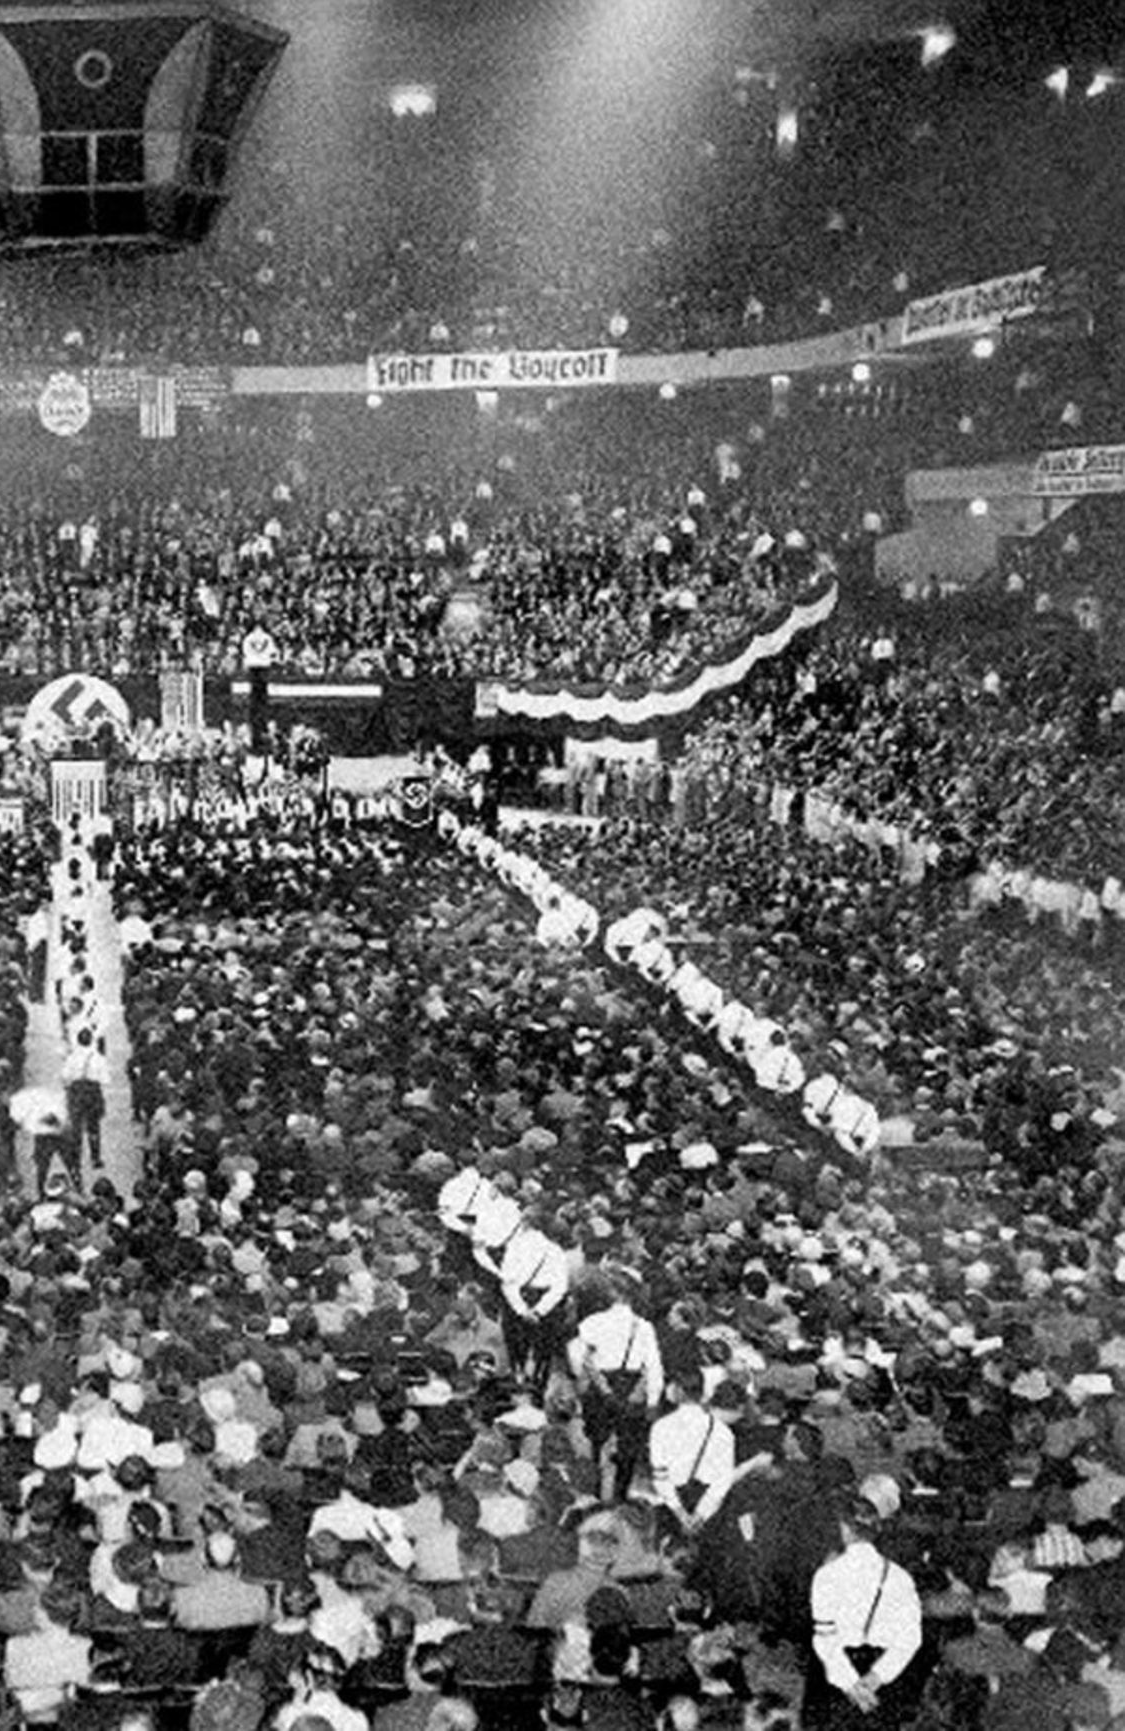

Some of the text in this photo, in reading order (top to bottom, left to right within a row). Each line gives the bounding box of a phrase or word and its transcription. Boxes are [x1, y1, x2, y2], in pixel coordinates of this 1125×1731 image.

[378, 353, 608, 386] Fight the Boycott
